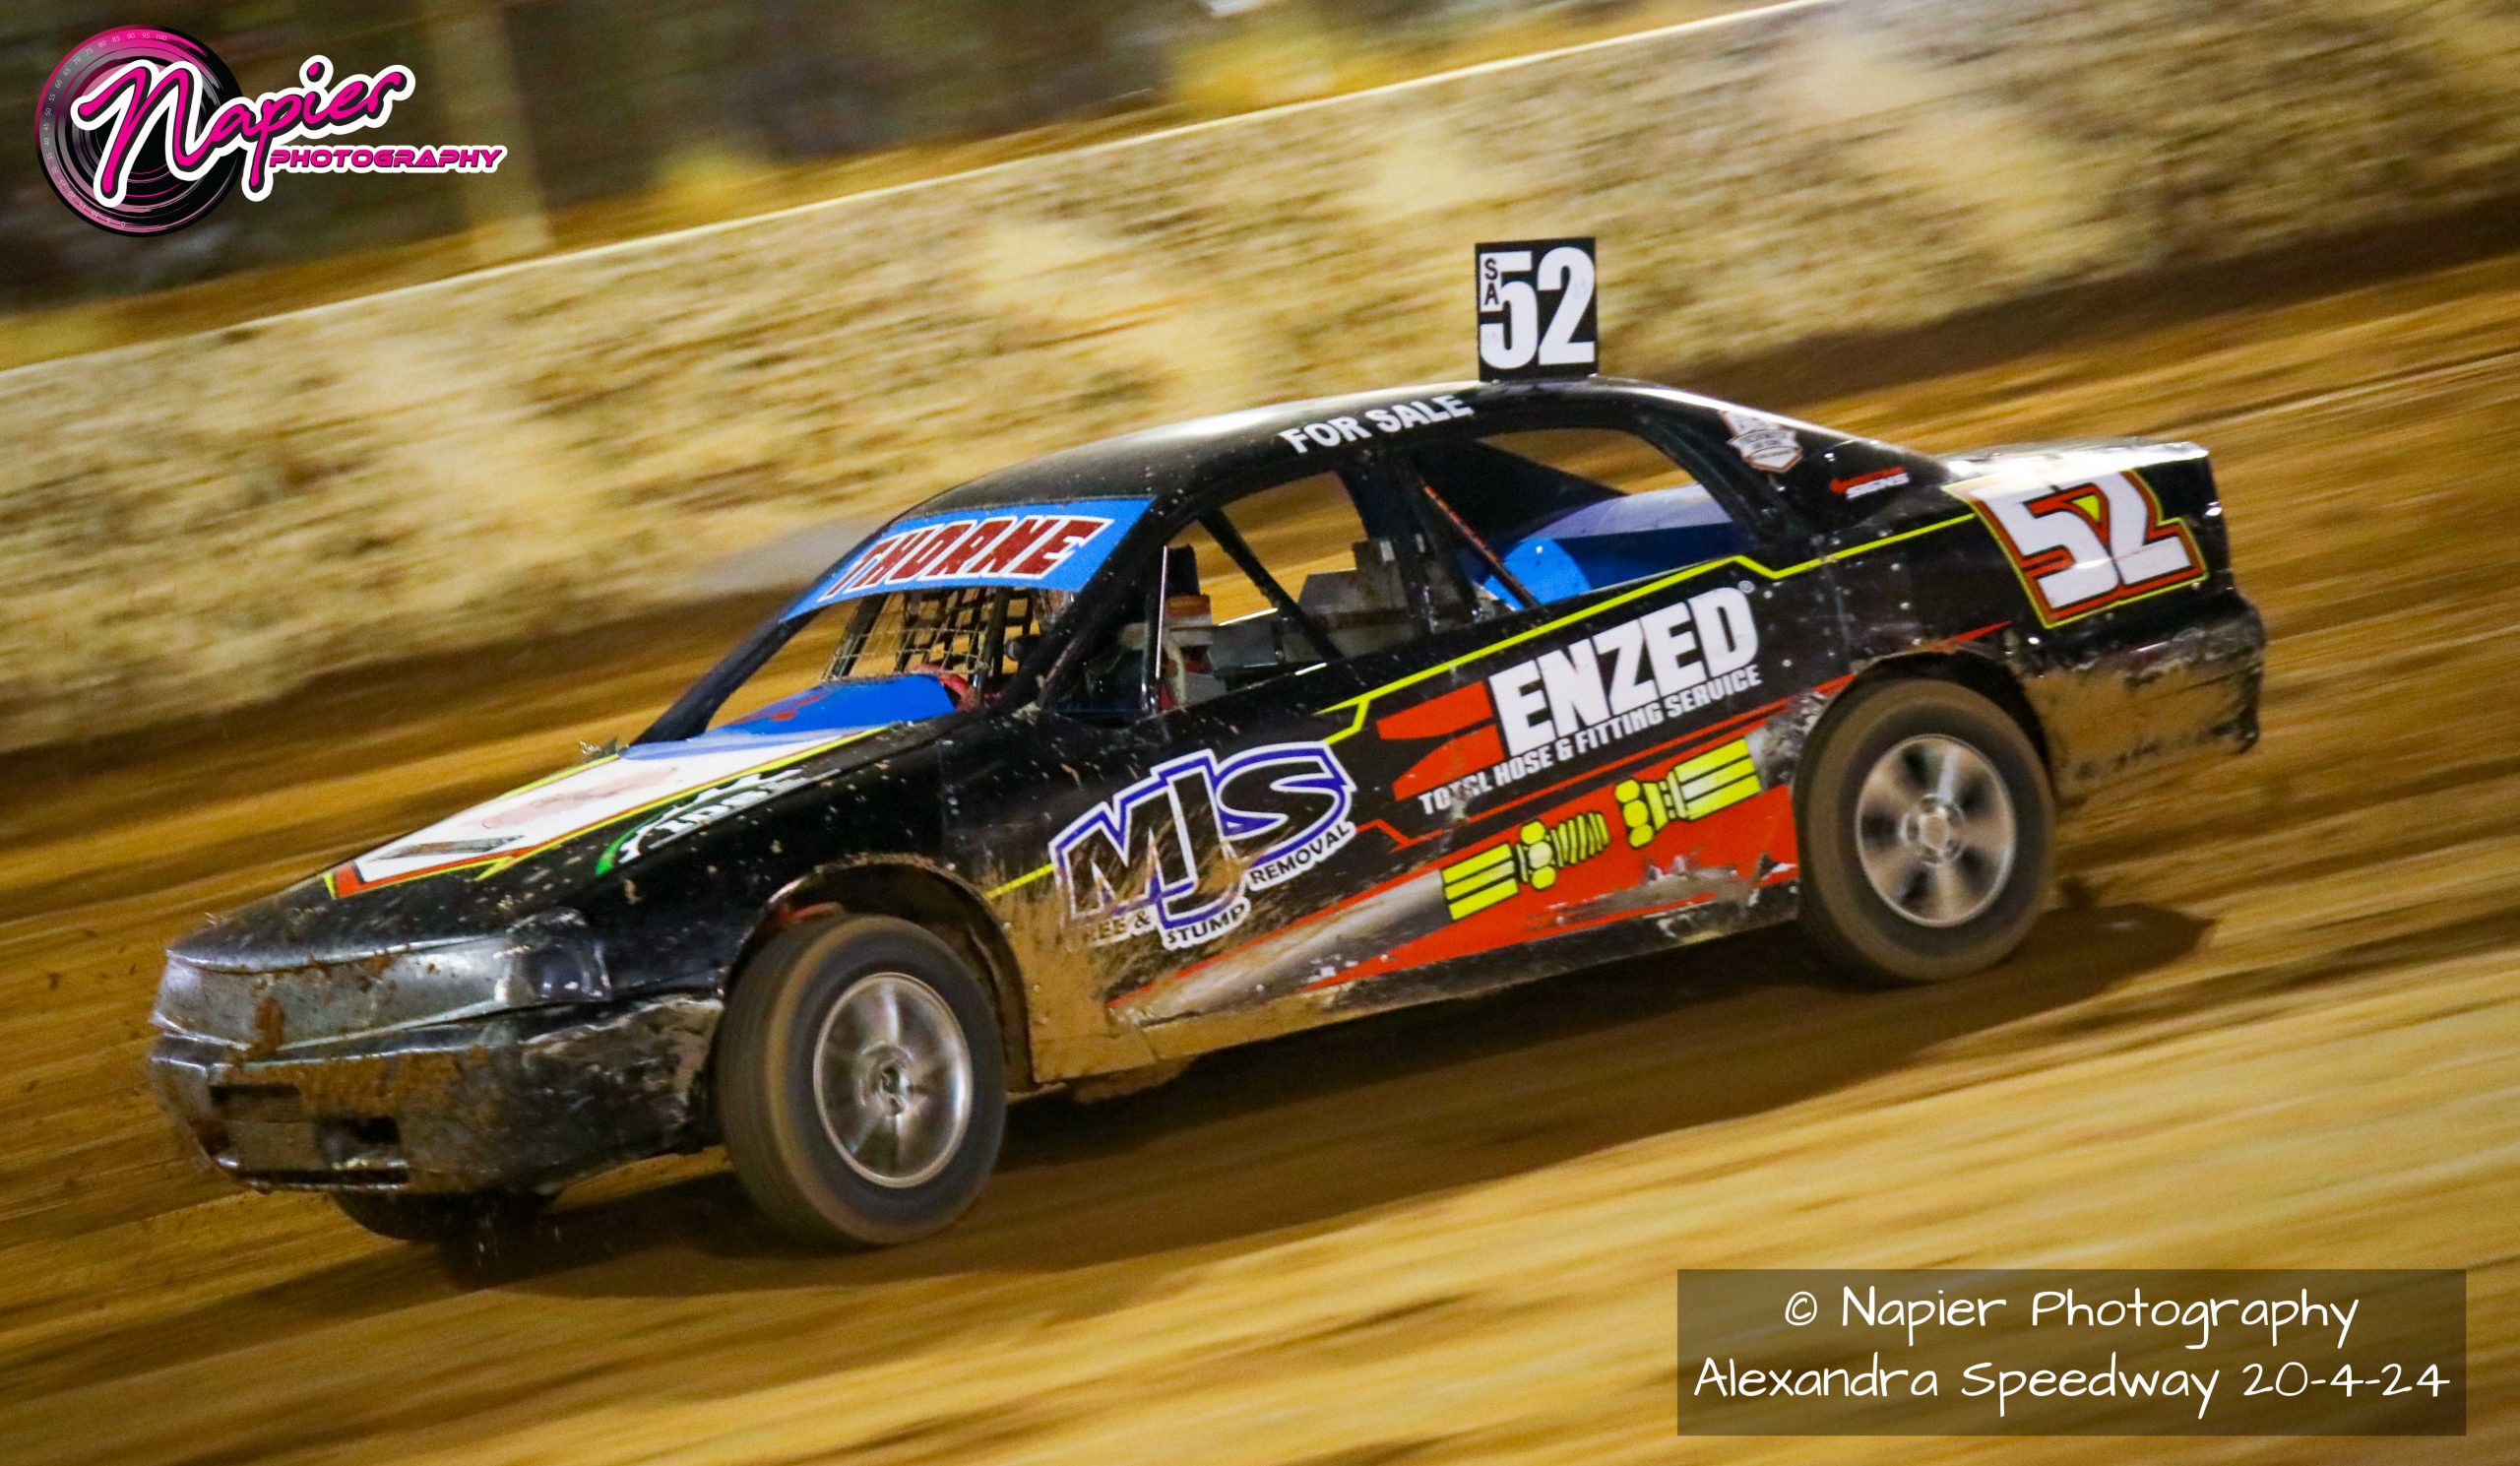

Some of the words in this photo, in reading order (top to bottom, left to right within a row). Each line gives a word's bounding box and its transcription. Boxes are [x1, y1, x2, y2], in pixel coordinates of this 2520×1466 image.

[1479, 246, 1596, 369] 52
[1483, 257, 1500, 306] SA
[1280, 415, 1373, 454] FOR
[1364, 394, 1475, 433] SALE
[818, 515, 1115, 602] THORNE
[1979, 471, 2201, 622] 52
[1489, 587, 1759, 756] ENZED
[1492, 743, 1554, 787] HOSE
[1556, 736, 1574, 761] &
[1575, 702, 1665, 753] FITTING
[1664, 664, 1763, 718] SERVICE
[1048, 741, 1356, 929] MJS
[1249, 825, 1351, 884] REMOVAL
[1166, 902, 1246, 944] STUMP
